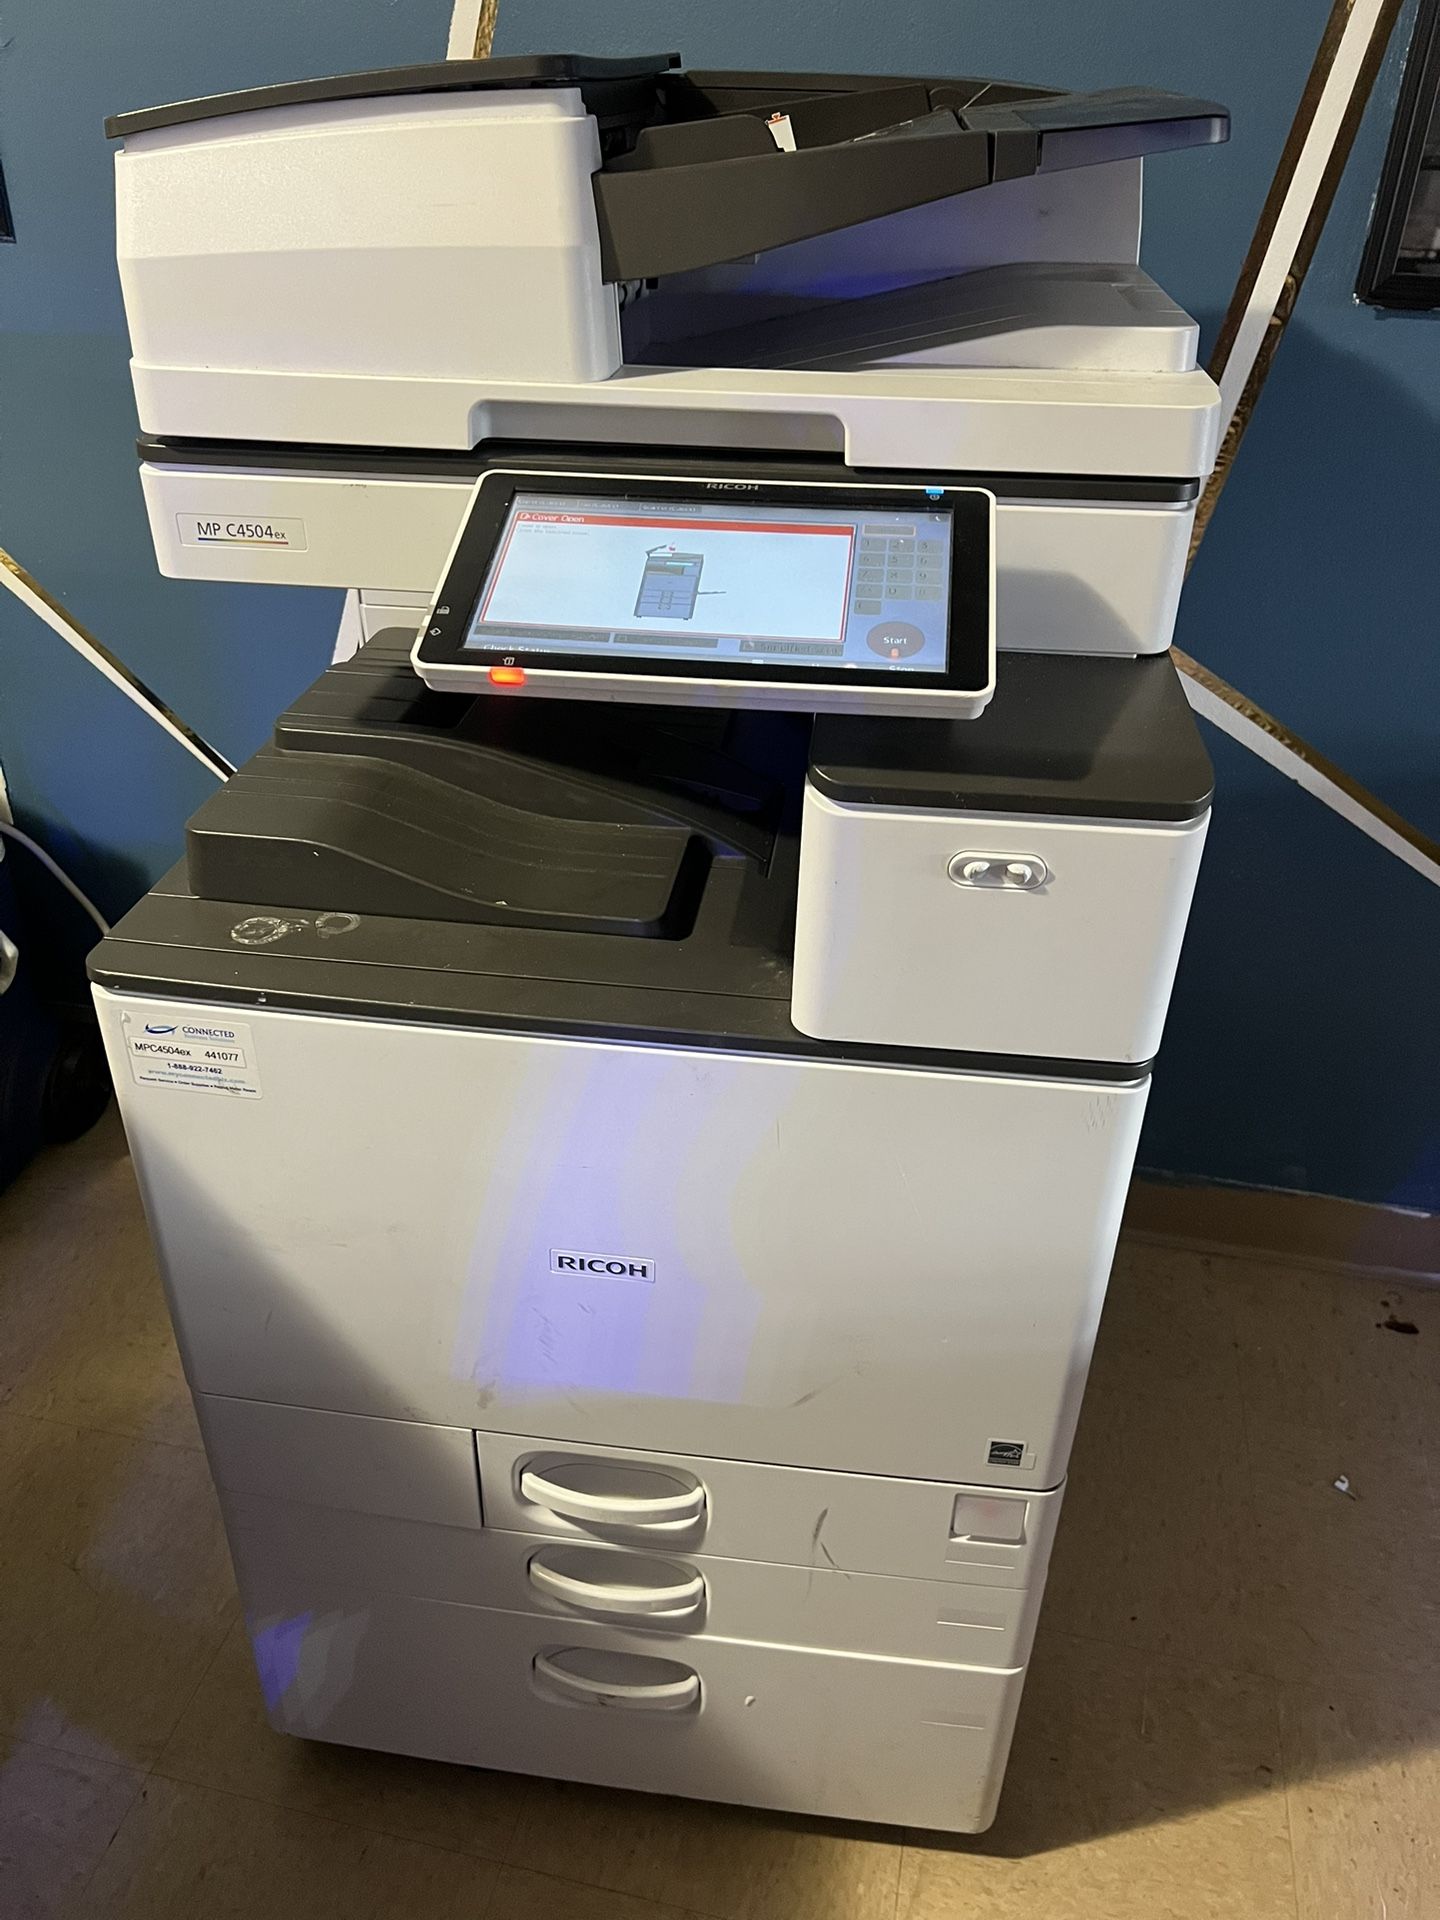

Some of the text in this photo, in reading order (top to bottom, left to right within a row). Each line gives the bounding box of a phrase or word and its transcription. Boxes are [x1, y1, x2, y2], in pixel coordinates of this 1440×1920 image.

[706, 483, 759, 491] RICOH
[532, 512, 584, 524] Cover Open
[197, 522, 287, 539] MP C4504ex
[883, 636, 907, 645] Start
[182, 1026, 235, 1038] CONNECTED
[134, 1043, 240, 1062] MPC4504ex 441077
[558, 1256, 647, 1278] RICOH
